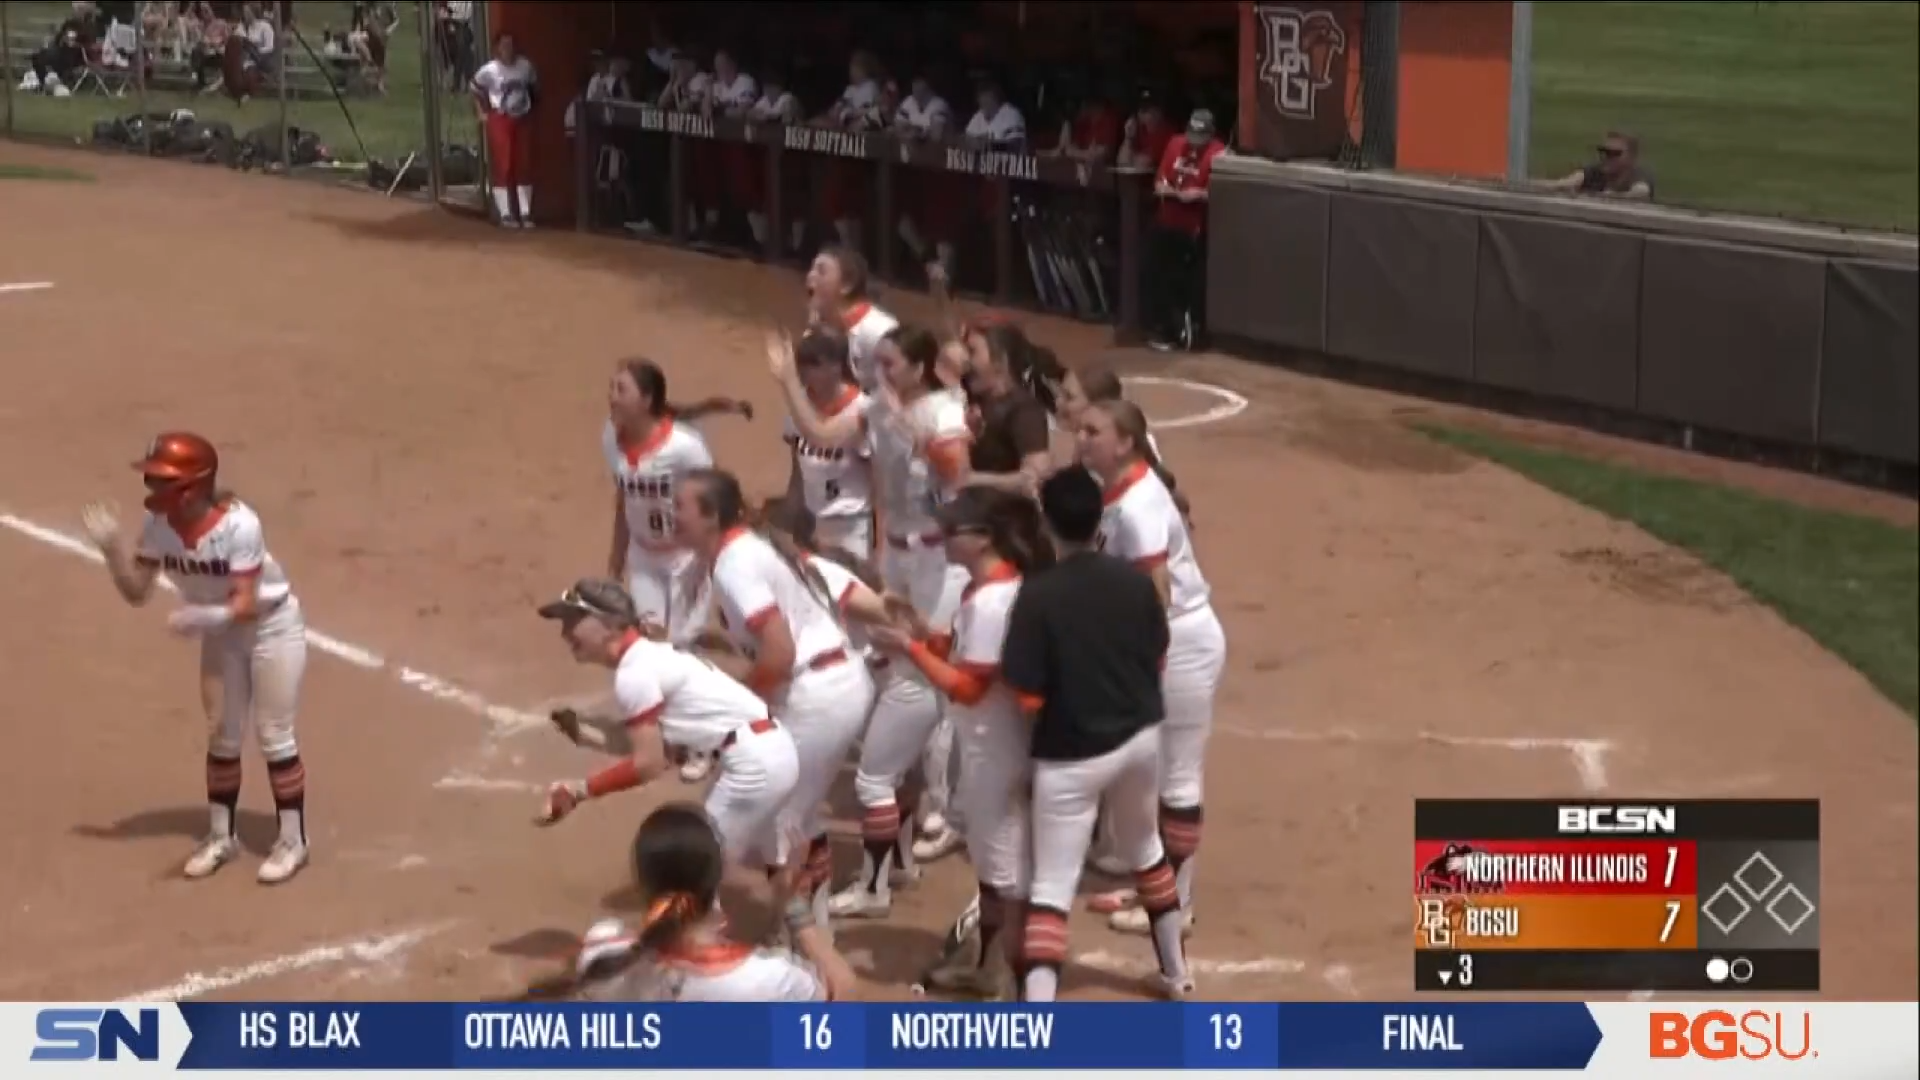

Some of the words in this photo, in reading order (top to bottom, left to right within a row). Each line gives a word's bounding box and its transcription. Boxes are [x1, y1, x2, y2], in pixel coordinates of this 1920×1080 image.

[785, 126, 811, 150] BGSU
[812, 130, 866, 158] SOFTBALL
[945, 148, 976, 174] BGSU
[979, 150, 1039, 181] SOFTBALL
